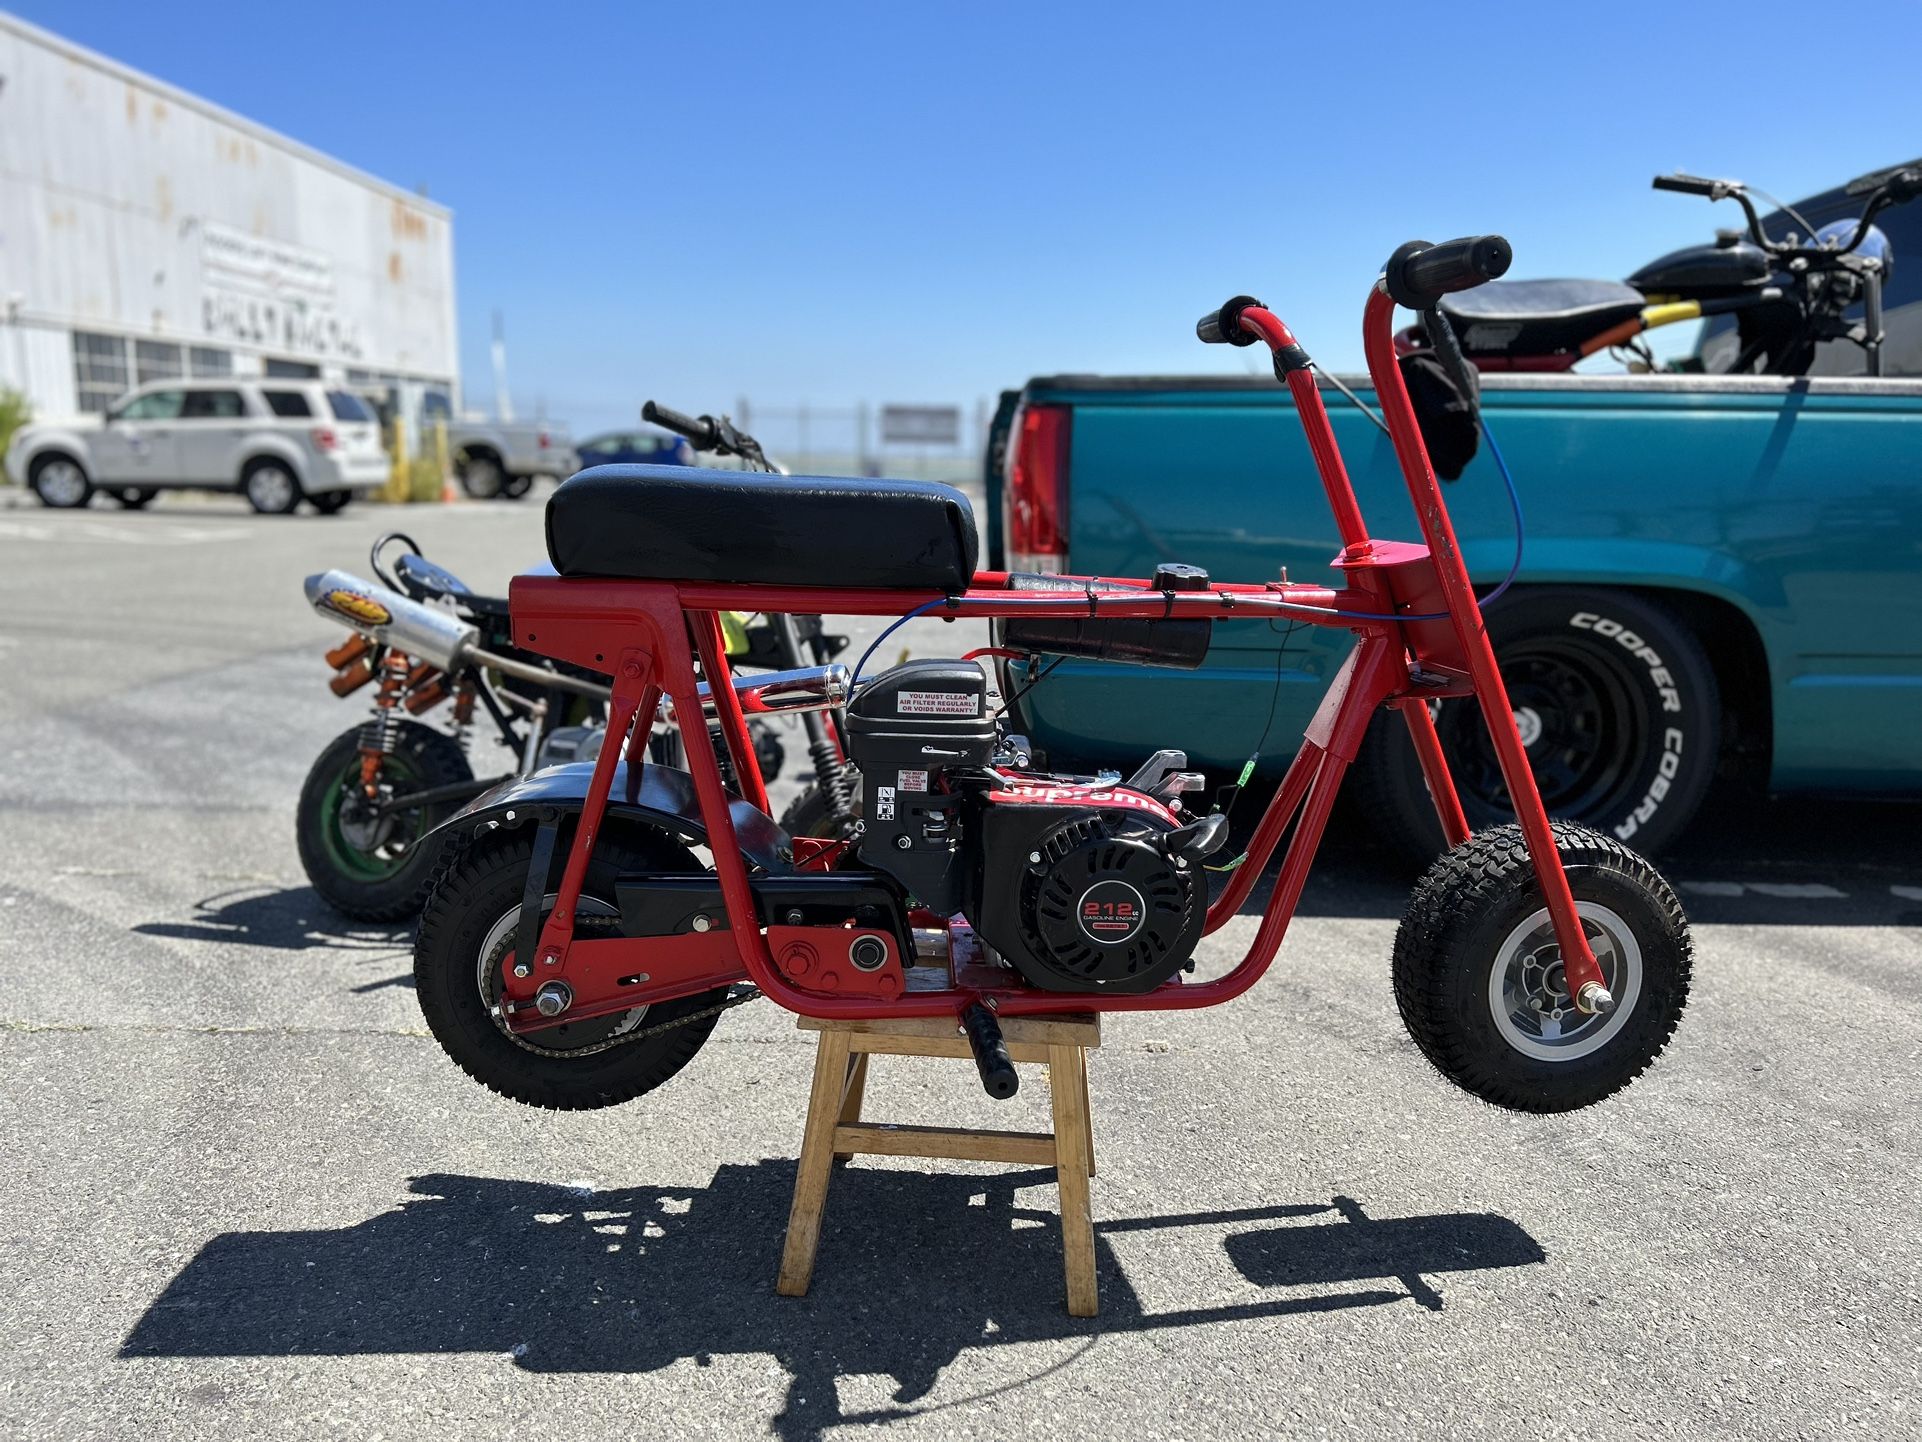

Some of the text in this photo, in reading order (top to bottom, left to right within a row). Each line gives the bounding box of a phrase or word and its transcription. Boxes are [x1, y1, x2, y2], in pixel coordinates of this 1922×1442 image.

[1570, 611, 1684, 841] COOPER COBRA
[1084, 902, 1133, 916] 212
